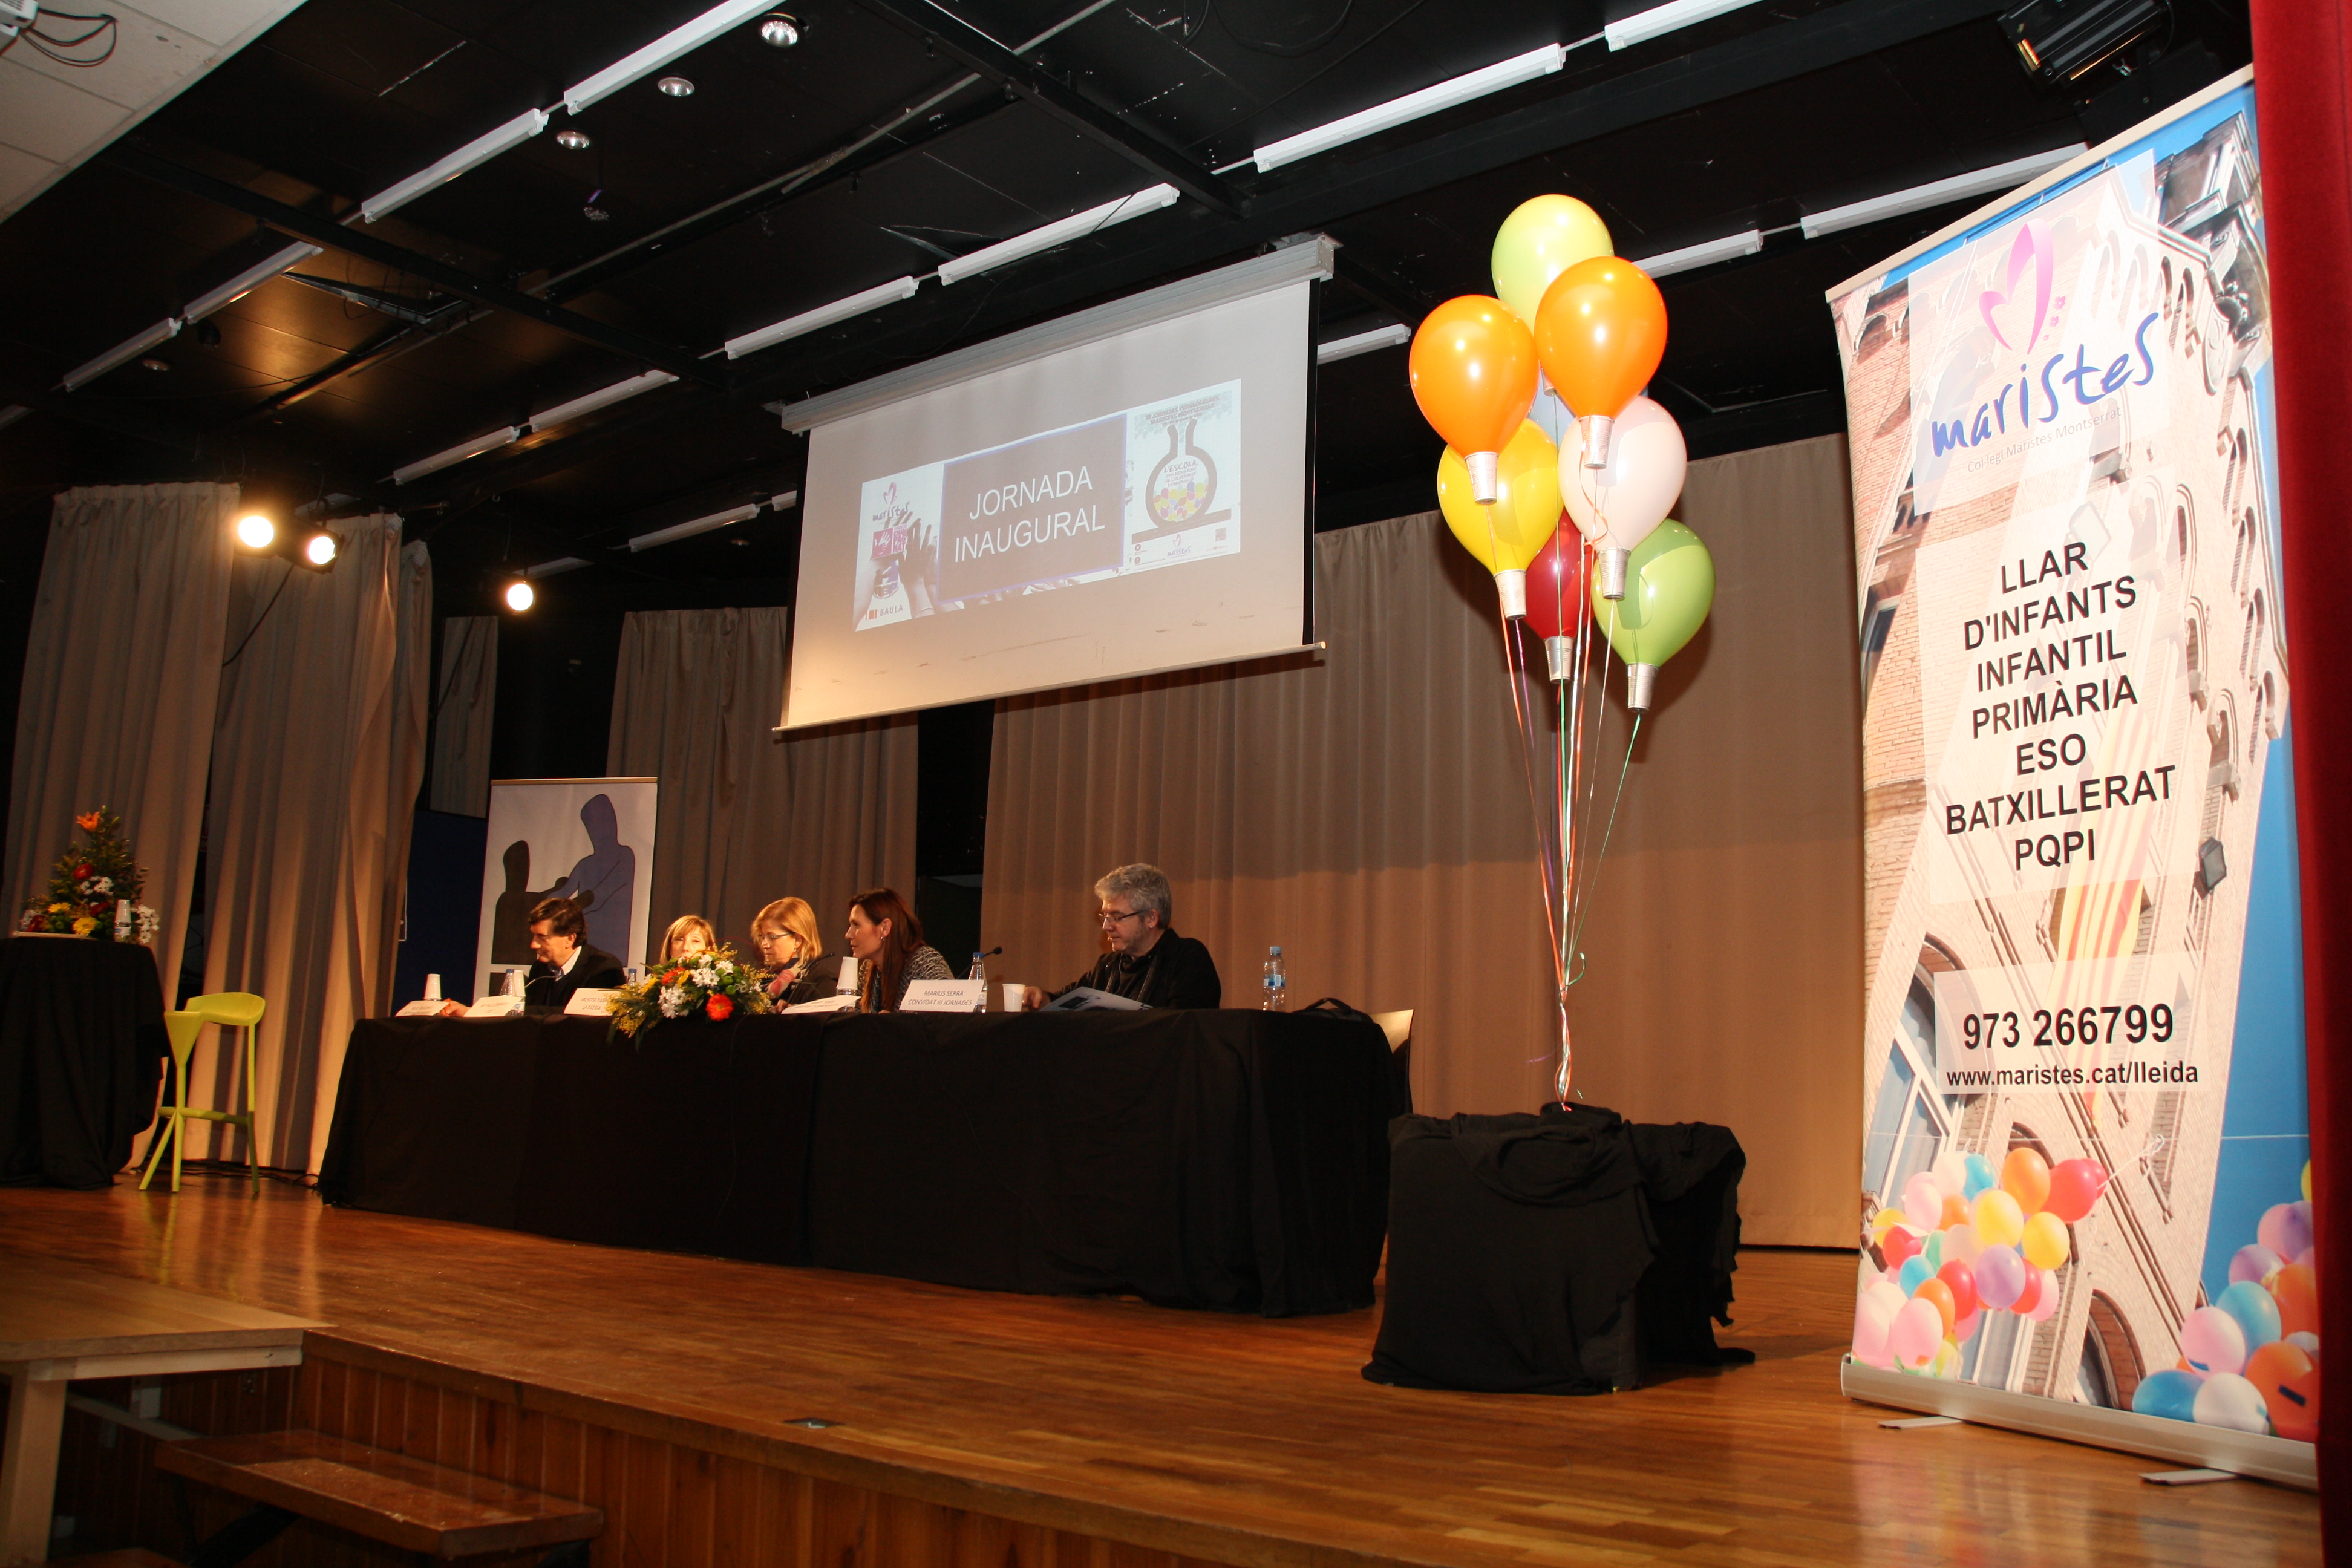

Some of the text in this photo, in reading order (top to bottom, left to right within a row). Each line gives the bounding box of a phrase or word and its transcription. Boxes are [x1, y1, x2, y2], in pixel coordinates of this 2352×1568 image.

[1932, 312, 2158, 457] maristes
[2007, 433, 2053, 457] Maristes
[2056, 406, 2122, 439] Montserrat
[872, 501, 910, 521] maristes
[970, 466, 1093, 520] JORNADA
[955, 505, 1105, 563] INAUGURAL
[2001, 542, 2088, 595] LLAR
[880, 605, 903, 616] BAULA
[1964, 575, 2137, 651] D'INFANTS
[1978, 629, 2126, 693] INFANTIL
[1972, 675, 2138, 739] PRIMÀRIA
[2016, 733, 2086, 776] ESO
[1946, 765, 2176, 835] BATXILLERAT
[2015, 829, 2095, 871] PQPI
[1963, 1003, 2174, 1050] 973 266799
[1947, 1060, 2198, 1086] www.maristes.cat/lleida
